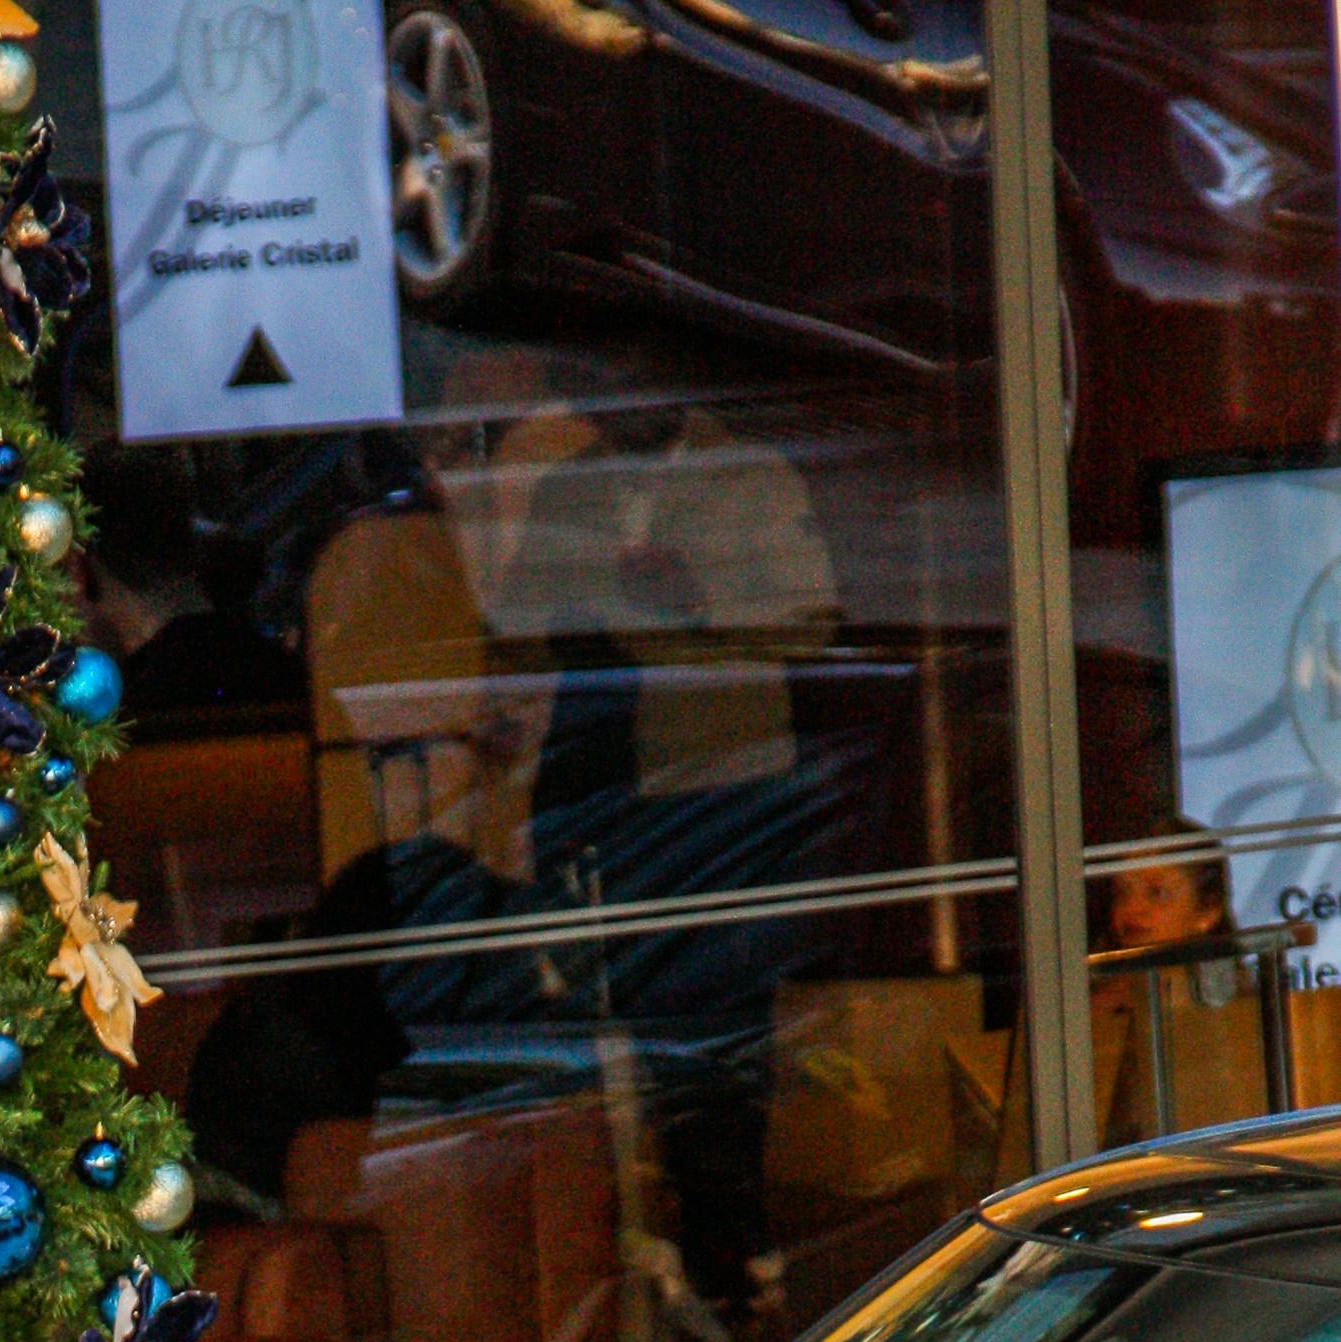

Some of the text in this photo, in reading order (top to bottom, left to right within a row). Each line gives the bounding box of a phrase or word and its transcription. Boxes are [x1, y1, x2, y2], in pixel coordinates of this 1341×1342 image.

[148, 235, 360, 275] Galerie Cristal
[1280, 882, 1341, 920] Cé
